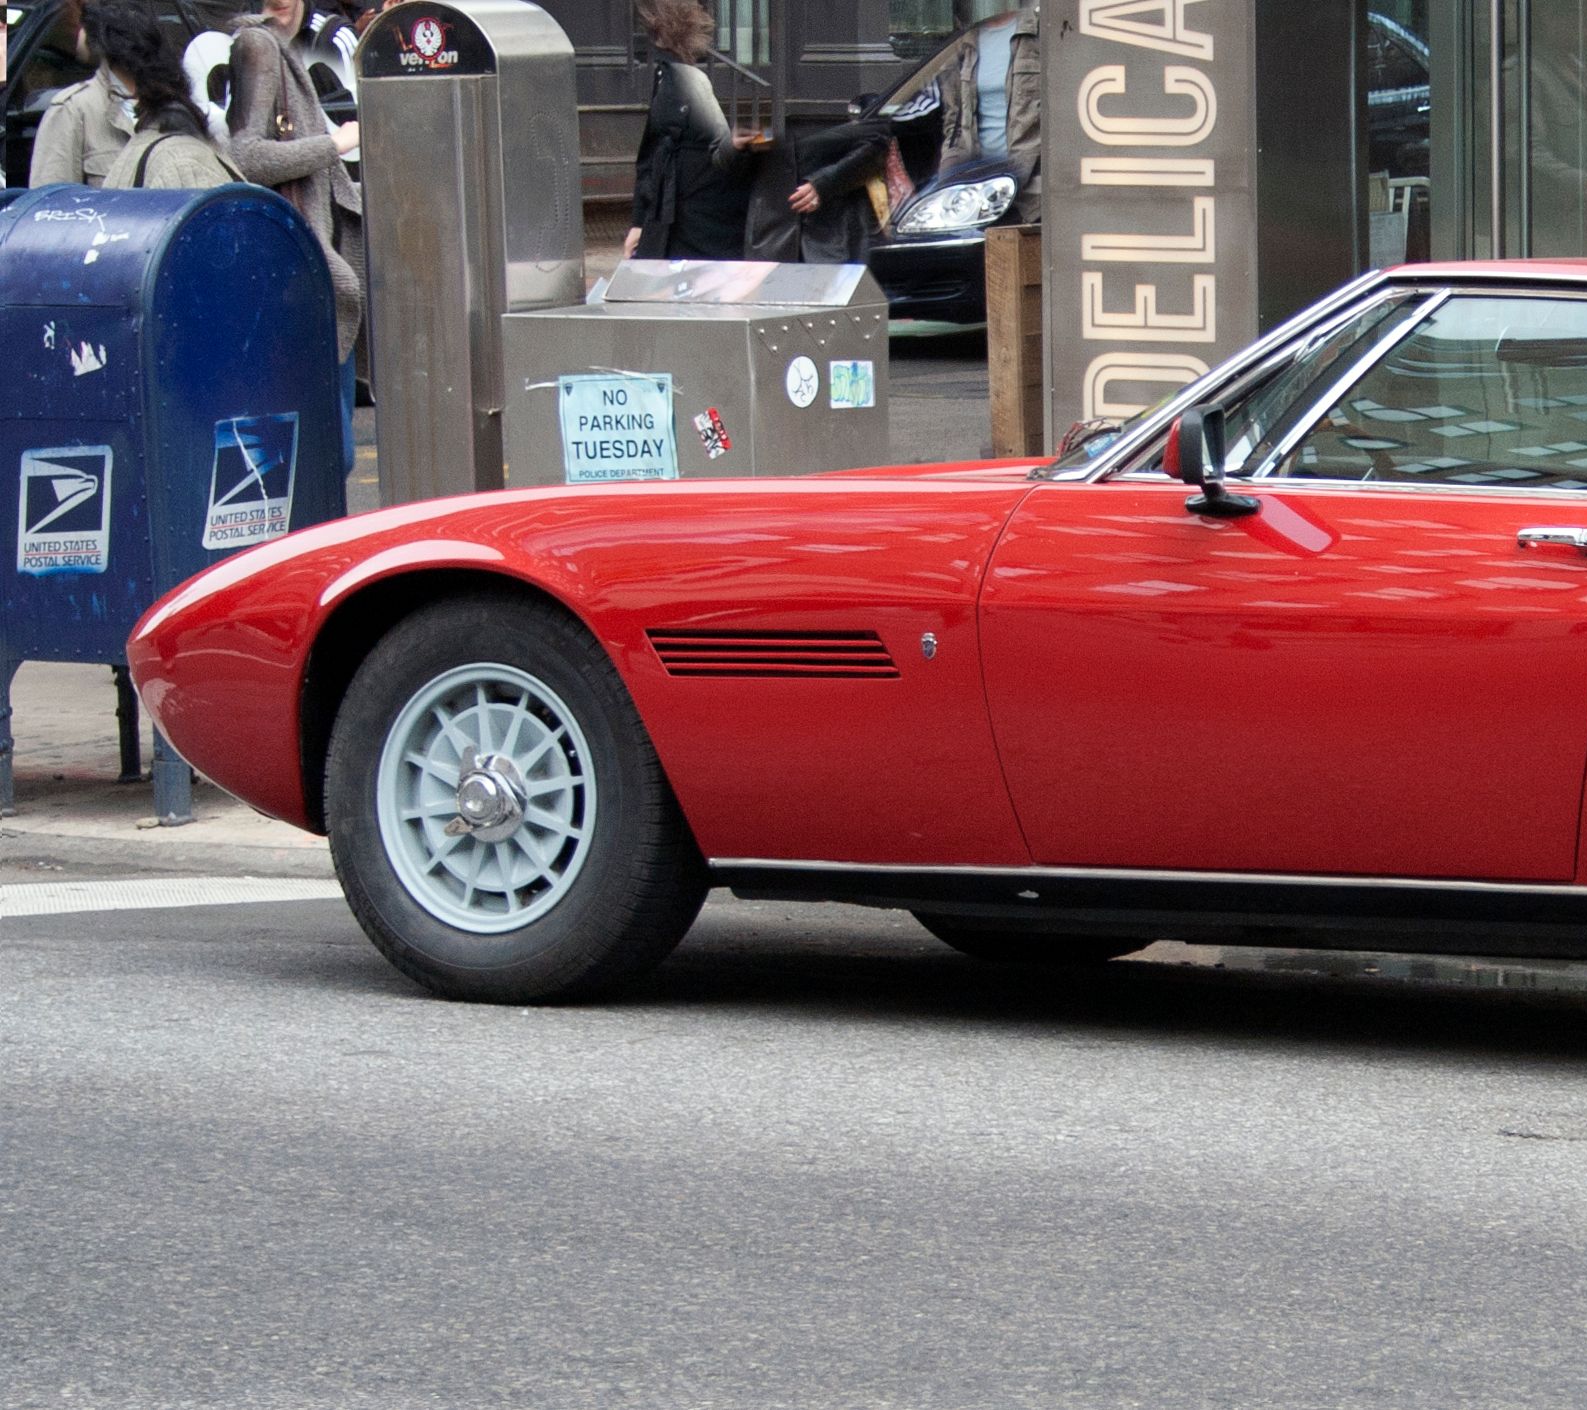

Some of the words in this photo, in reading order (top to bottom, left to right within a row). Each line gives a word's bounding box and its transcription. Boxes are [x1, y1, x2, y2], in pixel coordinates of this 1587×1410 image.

[602, 389, 628, 406] NO
[579, 413, 655, 432] PARKING
[571, 439, 664, 460] TUESDAY
[579, 469, 608, 479] POLICE
[610, 467, 664, 478] DEPARTMENT
[210, 511, 248, 526] UNITED
[249, 506, 282, 521] STATES
[209, 527, 245, 541] POSTAL
[24, 541, 62, 553] UNITED
[63, 539, 97, 551] STATES
[24, 556, 61, 568] POSTAL
[62, 554, 102, 567] SERVICE
